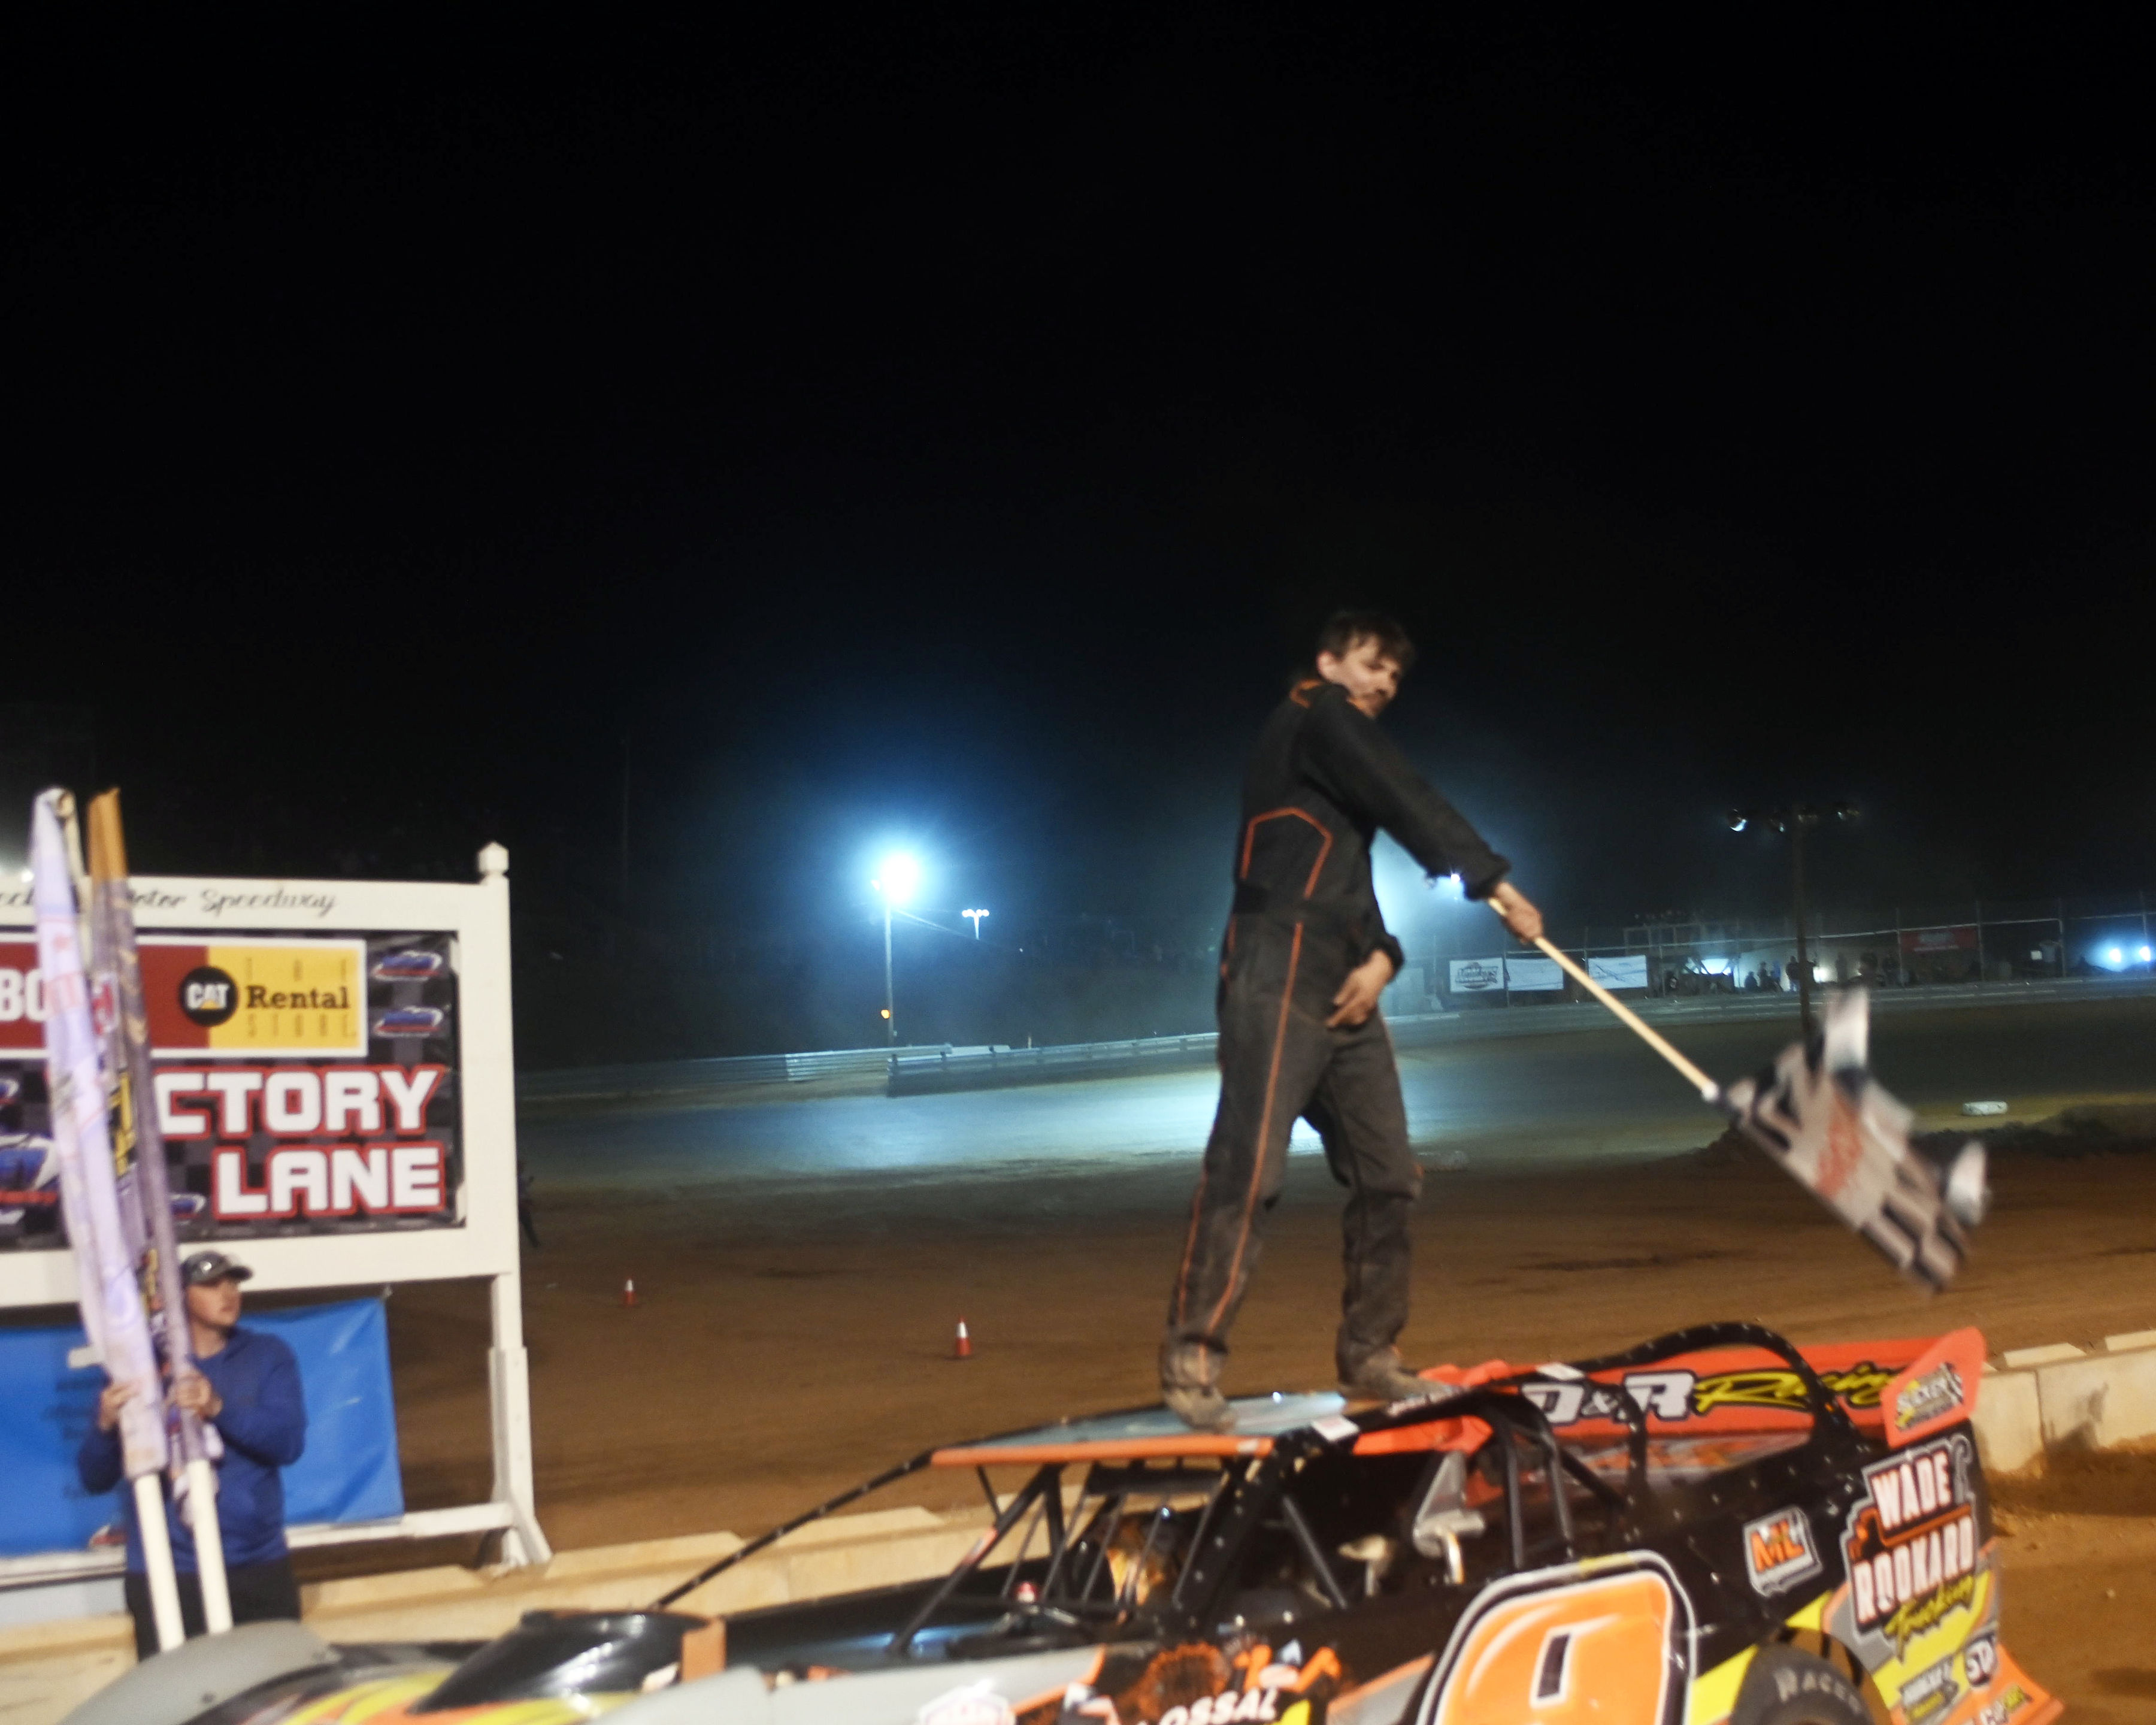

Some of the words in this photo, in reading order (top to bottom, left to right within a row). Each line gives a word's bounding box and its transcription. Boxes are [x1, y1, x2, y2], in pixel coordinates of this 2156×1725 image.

[199, 888, 336, 918] Speedway
[185, 982, 230, 1010] CAT
[246, 984, 350, 1009] Rental
[153, 1067, 442, 1137] CTORY
[214, 1144, 443, 1218] LANE
[1870, 1449, 1952, 1531] WADE
